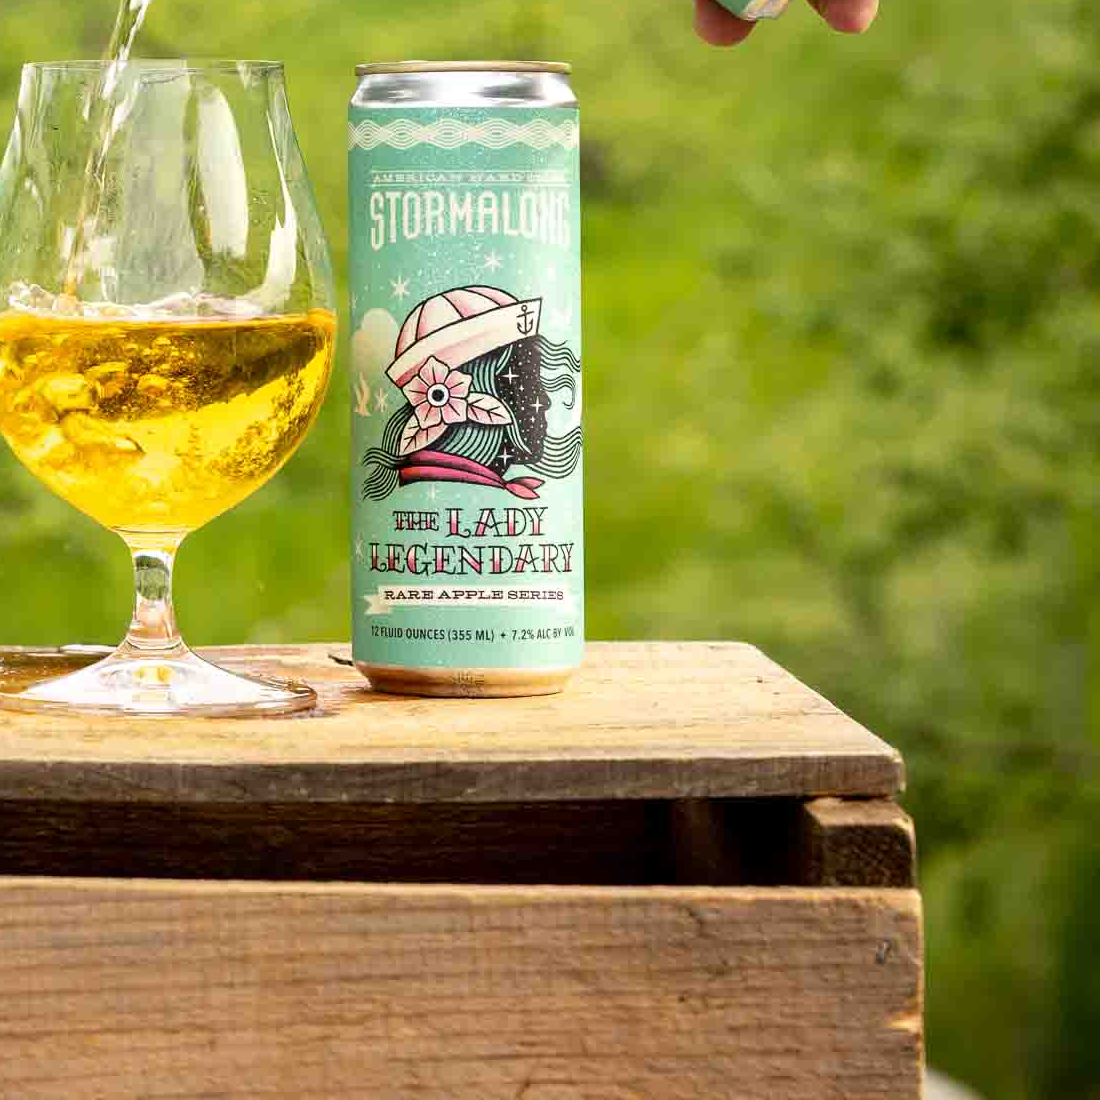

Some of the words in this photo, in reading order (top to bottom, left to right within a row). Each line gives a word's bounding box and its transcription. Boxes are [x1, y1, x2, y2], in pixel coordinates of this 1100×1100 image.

[370, 190, 571, 251] STORMALONG
[392, 510, 439, 531] THE
[445, 507, 549, 538] LADY
[369, 542, 575, 575] LEGENDARY
[384, 590, 434, 600] RARE
[438, 590, 504, 600] APPLE
[507, 590, 564, 600] SERIES
[371, 625, 379, 637] 12
[380, 626, 403, 638] FLUID
[406, 628, 445, 640] OUNCES
[448, 629, 472, 642] (355
[475, 629, 495, 642] ML)
[512, 629, 534, 641] 7.2%
[537, 629, 551, 640] ALC
[553, 628, 563, 638] BY
